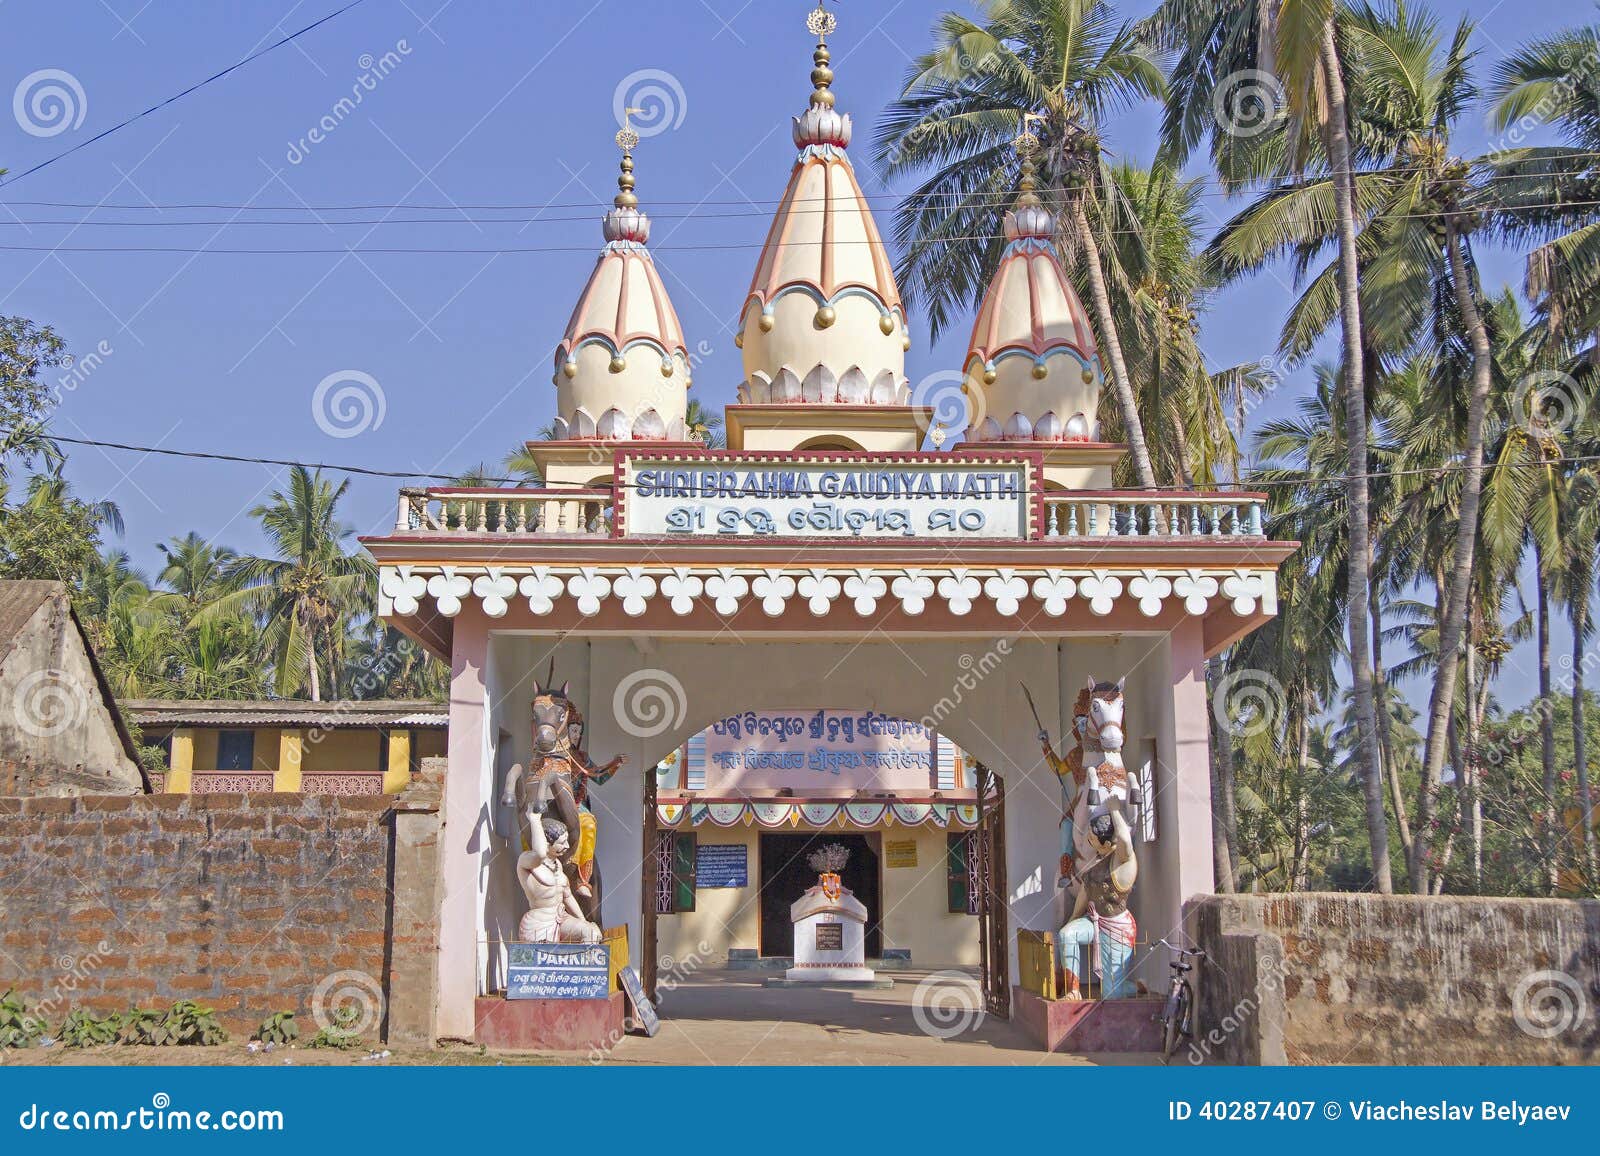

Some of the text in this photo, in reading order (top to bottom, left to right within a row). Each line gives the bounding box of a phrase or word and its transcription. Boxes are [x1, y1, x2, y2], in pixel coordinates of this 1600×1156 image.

[635, 470, 1018, 500] SHRI BRAHMA GAUDIYA MATH
[537, 948, 606, 965] PARKING
